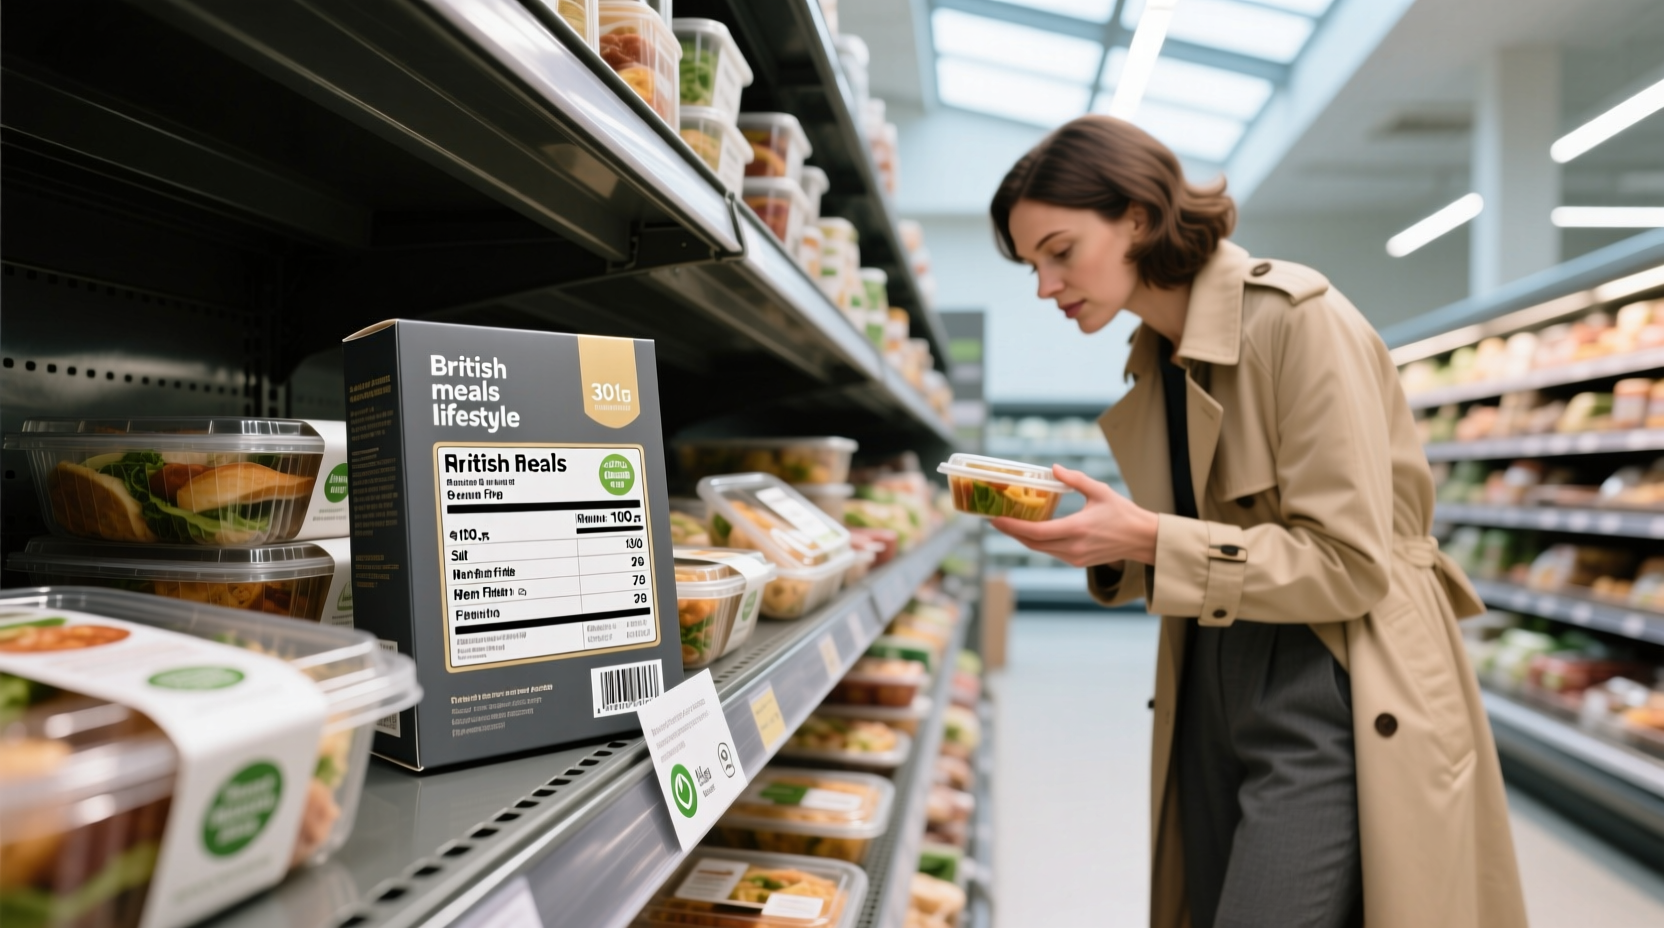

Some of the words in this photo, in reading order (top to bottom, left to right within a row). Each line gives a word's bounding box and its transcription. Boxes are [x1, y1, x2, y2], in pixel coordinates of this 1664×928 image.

[430, 355, 506, 379] British
[432, 381, 500, 402] meals
[433, 404, 520, 432] lifestyle
